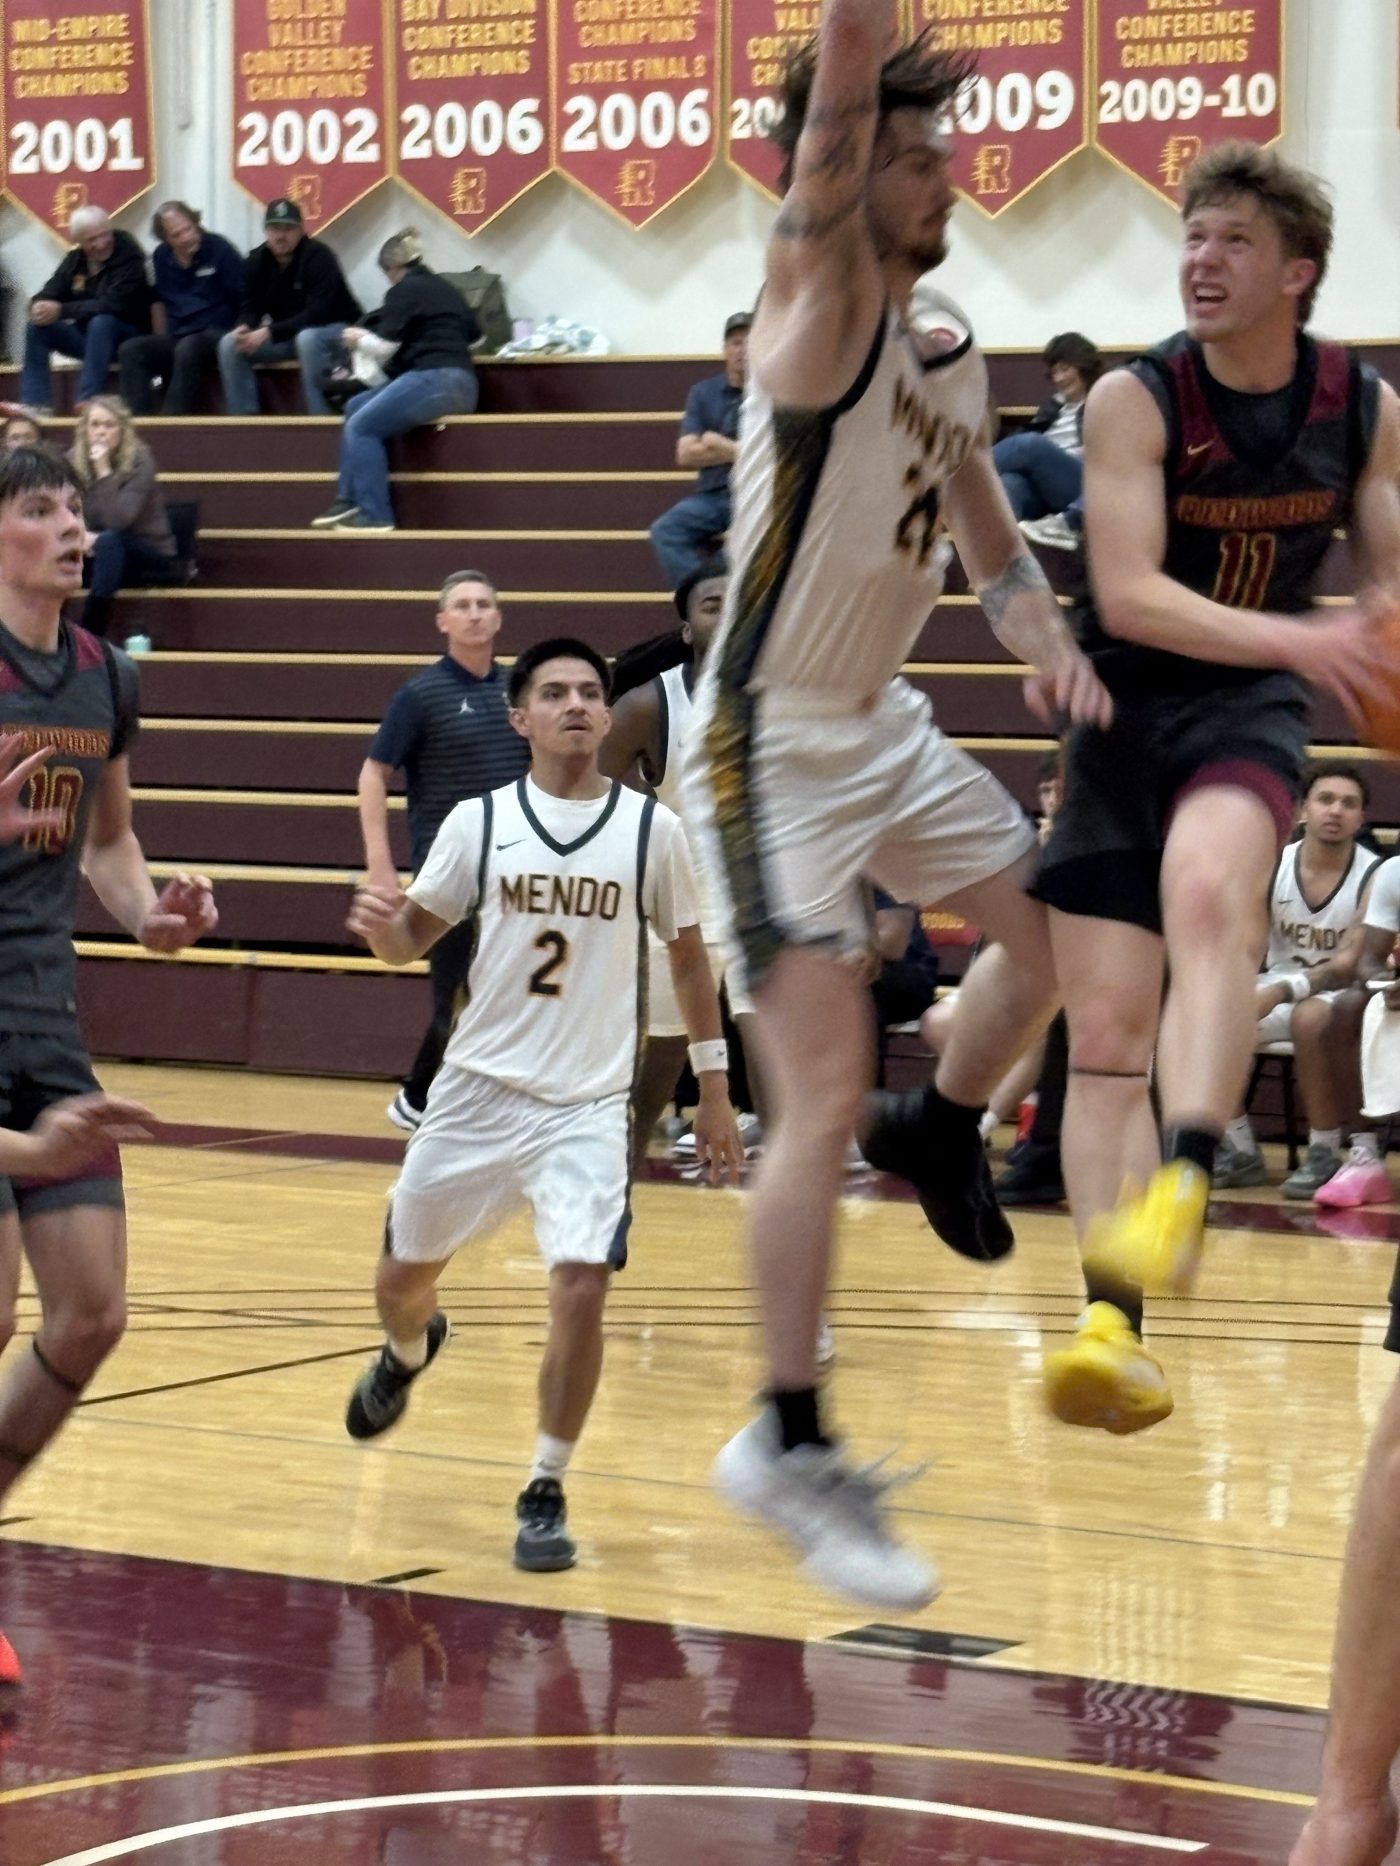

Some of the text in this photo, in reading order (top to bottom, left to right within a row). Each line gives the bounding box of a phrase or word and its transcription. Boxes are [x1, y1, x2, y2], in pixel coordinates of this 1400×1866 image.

[267, 20, 346, 47] VALLEY
[578, 19, 697, 48] CHAMPIONS
[774, 7, 823, 31] VALL
[1115, 10, 1256, 40] CONFERENCE
[402, 20, 537, 51] CONFERENCE
[9, 41, 134, 71] CONFERENCE
[240, 45, 374, 75] CONFERENCE
[407, 49, 531, 80] CHAMPIONS
[1121, 39, 1249, 68] CHAMPIONS
[14, 71, 130, 99] CHAMPIONS
[567, 55, 707, 85] STATE FINALS
[246, 73, 367, 101] CHAMPIONS
[931, 70, 1075, 135] 009
[1099, 72, 1276, 123] 2009-10
[400, 98, 544, 160] 2006
[561, 88, 711, 152] 2006
[8, 118, 145, 174] 2001
[237, 107, 381, 167] 2002
[500, 873, 622, 921] MENDO
[1280, 921, 1347, 952] MEND
[528, 930, 569, 997] 2
